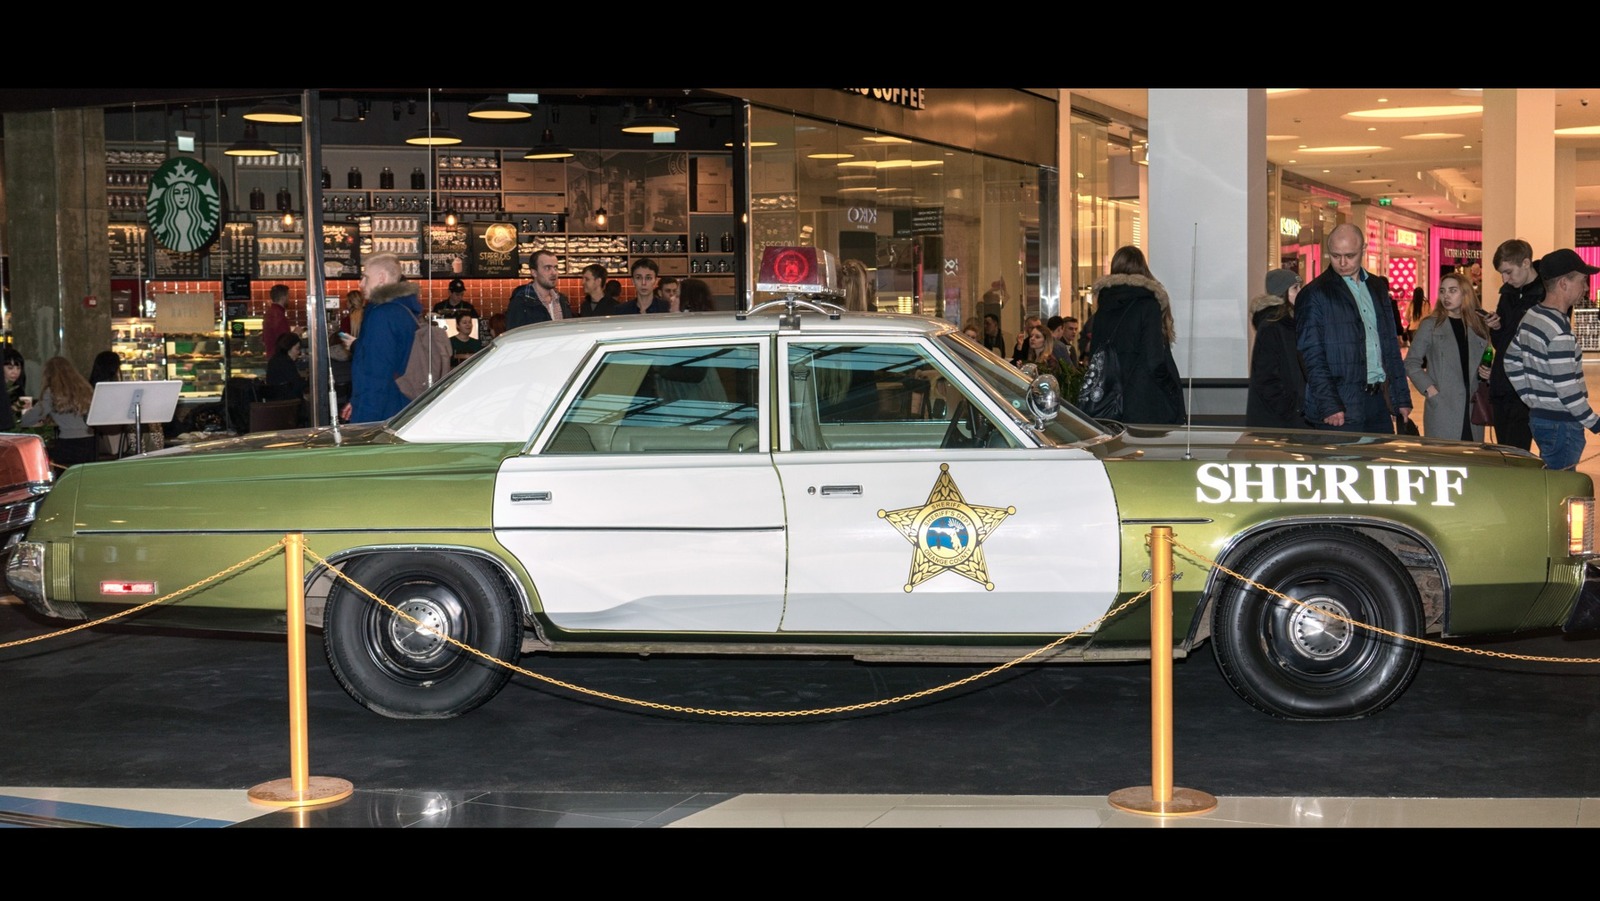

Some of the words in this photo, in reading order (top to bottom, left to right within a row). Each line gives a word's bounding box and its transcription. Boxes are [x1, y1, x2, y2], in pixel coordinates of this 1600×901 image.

[873, 88, 925, 109] COFFEE
[1196, 463, 1468, 506] SHERIFF
[931, 501, 962, 510] SHERIFF
[924, 510, 956, 527] SHERIFF'S
[956, 513, 972, 527] DEPT
[924, 548, 948, 565] ORANGE
[948, 547, 972, 565] COUNTY
